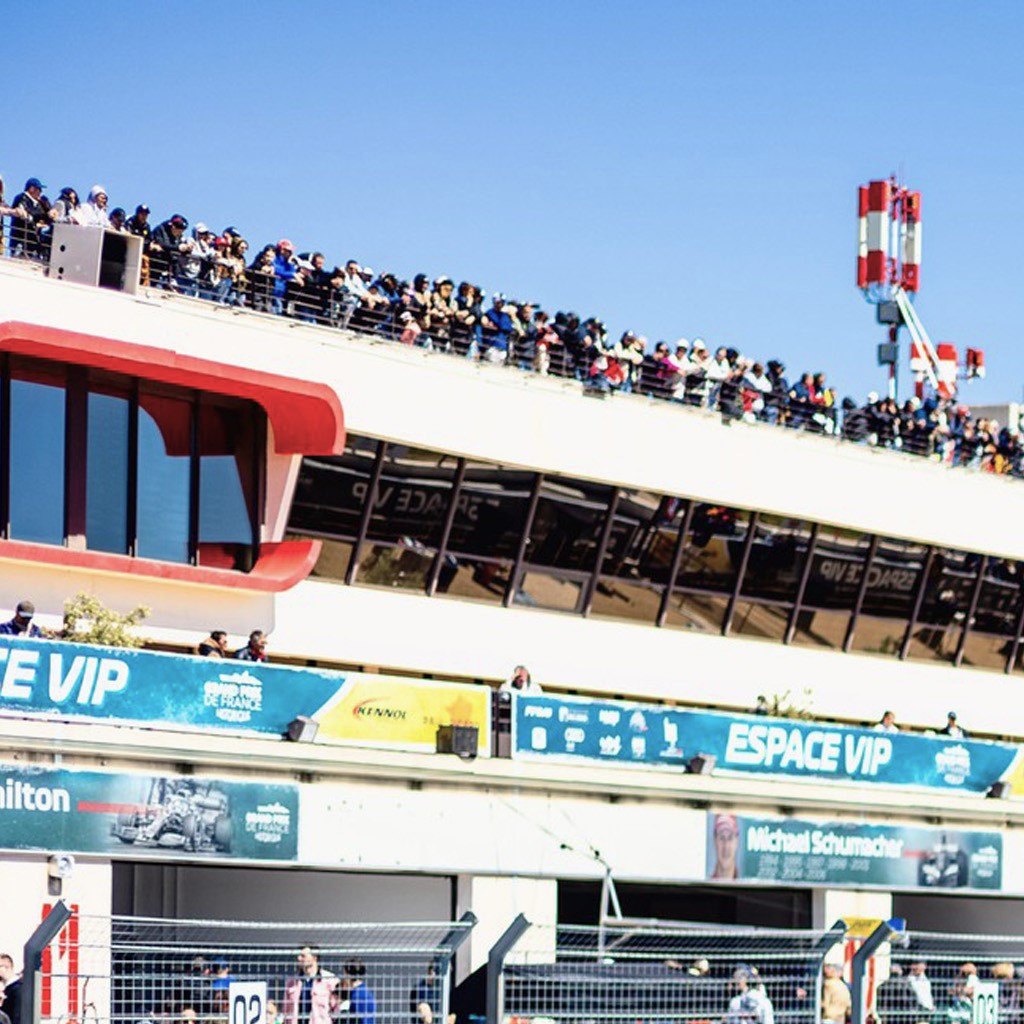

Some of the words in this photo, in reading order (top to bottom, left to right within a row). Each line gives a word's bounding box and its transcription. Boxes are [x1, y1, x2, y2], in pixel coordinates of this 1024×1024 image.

[0, 647, 40, 699] E
[48, 652, 130, 706] VIP
[725, 722, 842, 772] ESPACE
[844, 733, 893, 776] VIP
[747, 827, 810, 855] Michael
[811, 830, 903, 859] Schumacher
